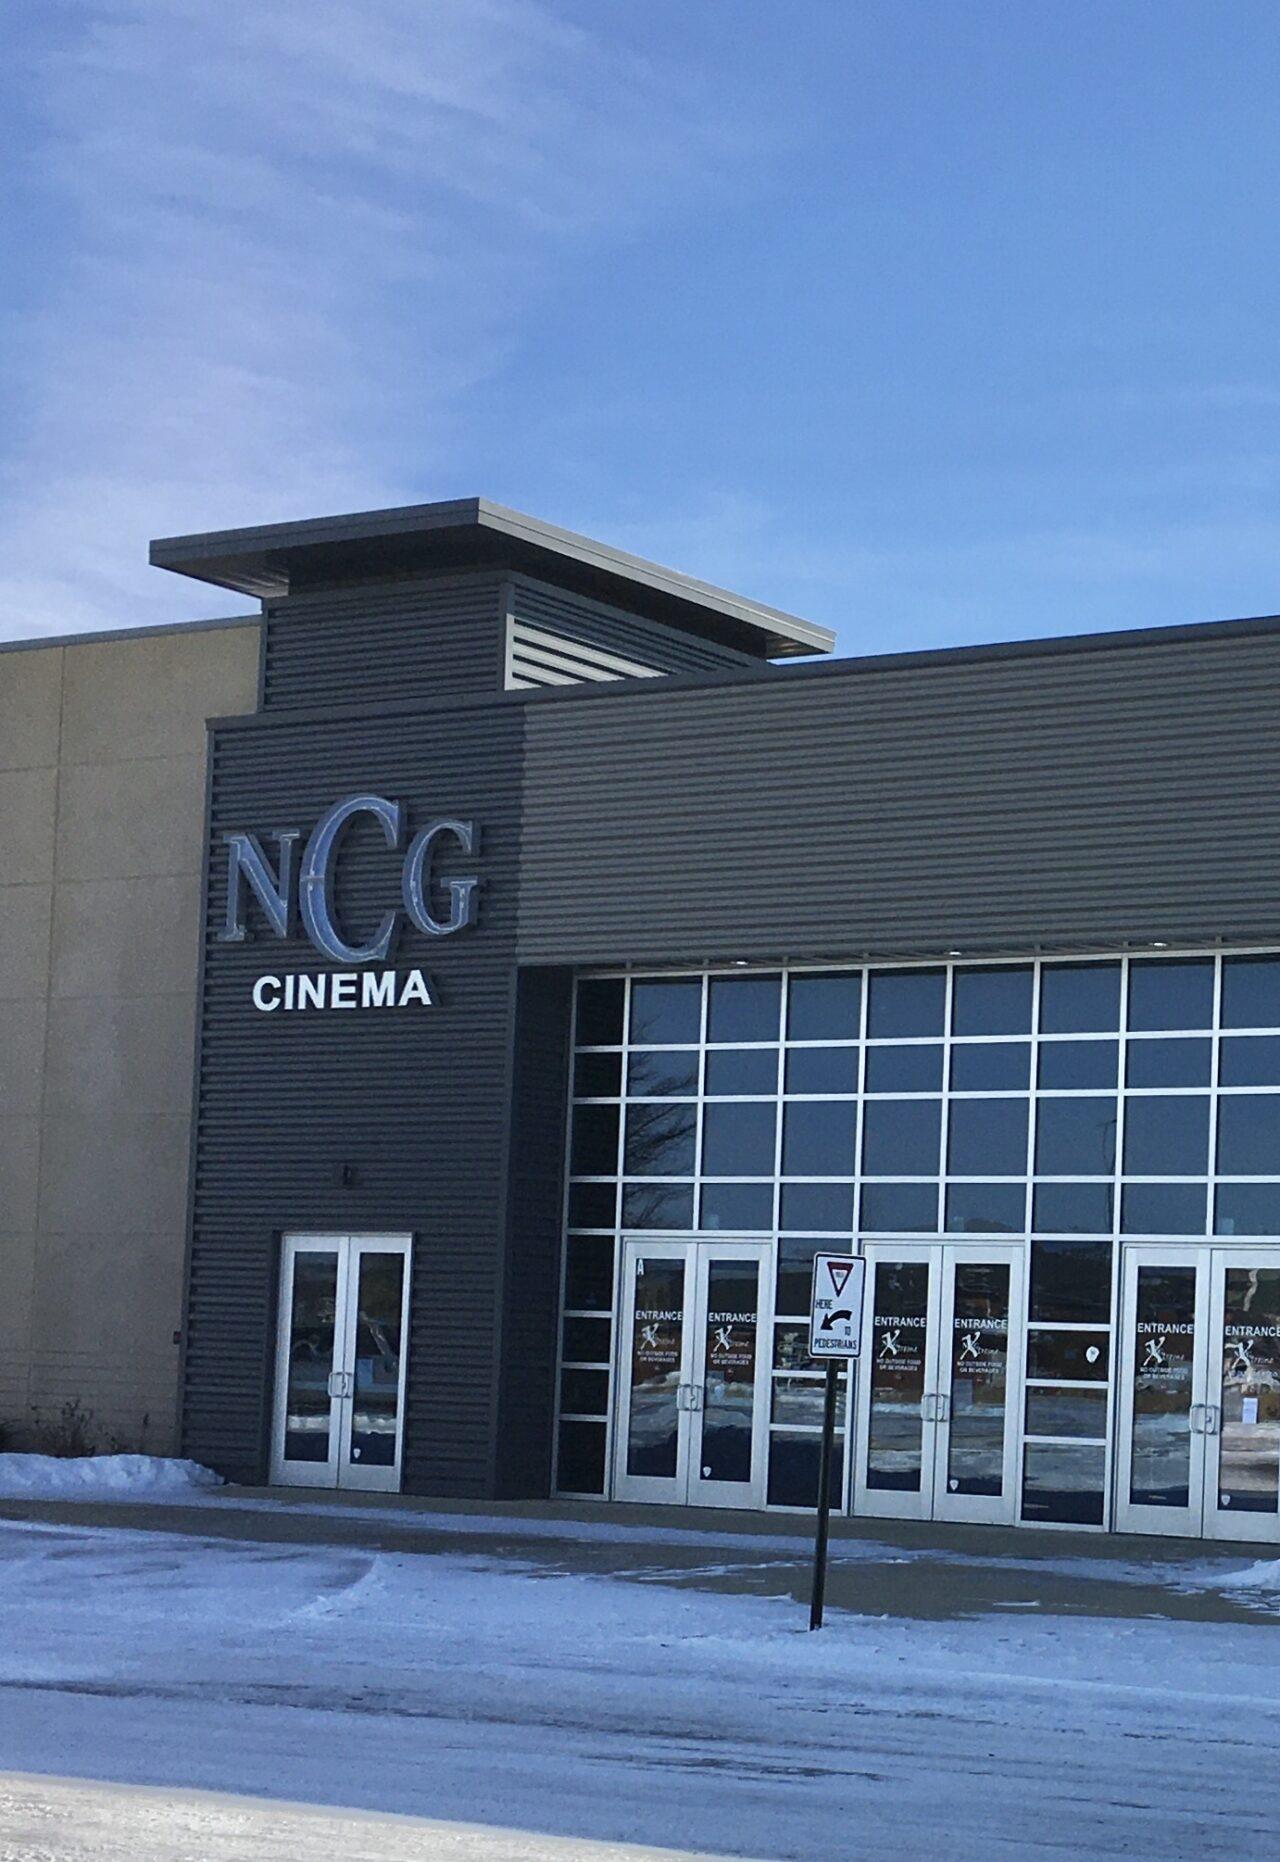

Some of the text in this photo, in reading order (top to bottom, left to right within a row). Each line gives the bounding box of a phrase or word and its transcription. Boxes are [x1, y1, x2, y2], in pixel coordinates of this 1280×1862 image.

[217, 794, 479, 963] NCG
[252, 969, 432, 1012] CINEMA
[815, 1299, 833, 1309] HERE
[635, 1310, 682, 1320] ENTRANCE
[708, 1312, 757, 1323] ENTRANCE
[874, 1316, 926, 1327] ENTRANCE
[954, 1318, 1007, 1329] ENTRANCE
[1137, 1322, 1194, 1334] ENTRANCE
[814, 1338, 857, 1349] PEDESTRIANS
